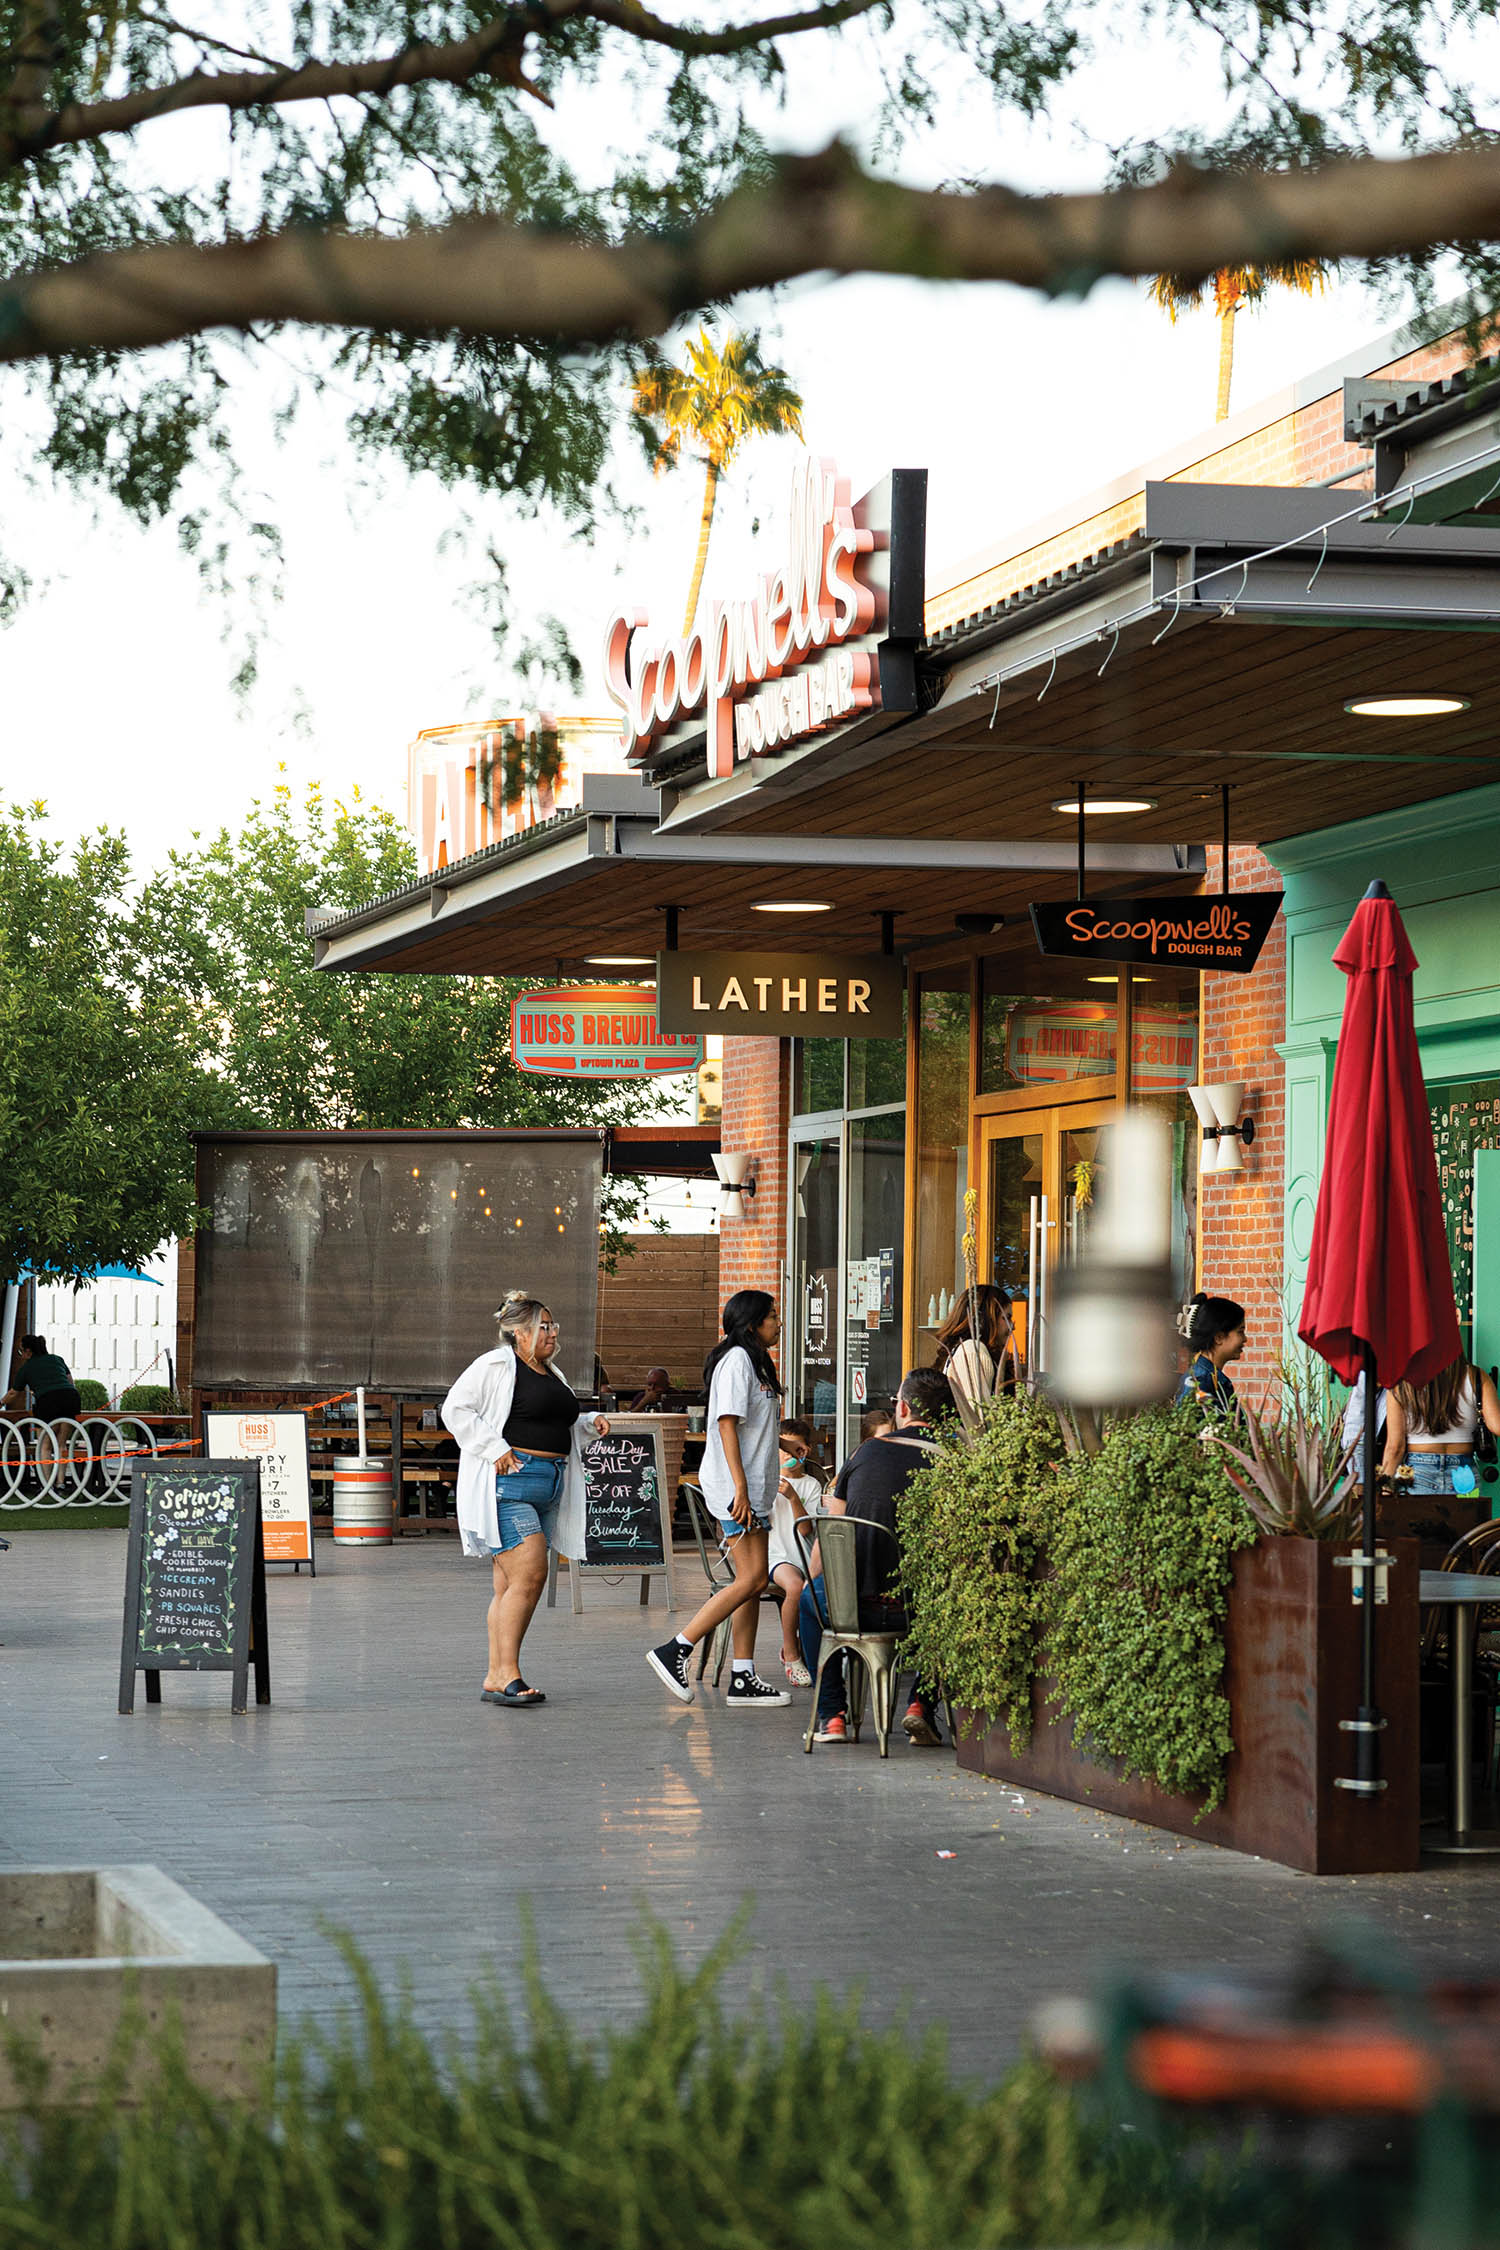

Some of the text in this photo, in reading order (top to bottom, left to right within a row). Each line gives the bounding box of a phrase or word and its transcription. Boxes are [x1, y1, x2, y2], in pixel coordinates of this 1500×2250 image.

[1065, 904, 1251, 955] Scoopwell's
[1168, 943, 1242, 957] DOUGH BAR
[692, 976, 871, 1013] LATHER
[520, 1014, 575, 1045] HUSS
[580, 1058, 640, 1068] UPTOWN PLAZA
[245, 1423, 269, 1434] HUSS
[587, 1456, 632, 1474] SALE
[611, 1484, 632, 1498] OFF
[180, 1535, 193, 1545] WE
[162, 1558, 227, 1567] COOKIE DOUGH
[176, 1602, 221, 1614] SQUARES
[155, 1625, 222, 1638] CHIP COOKIES
